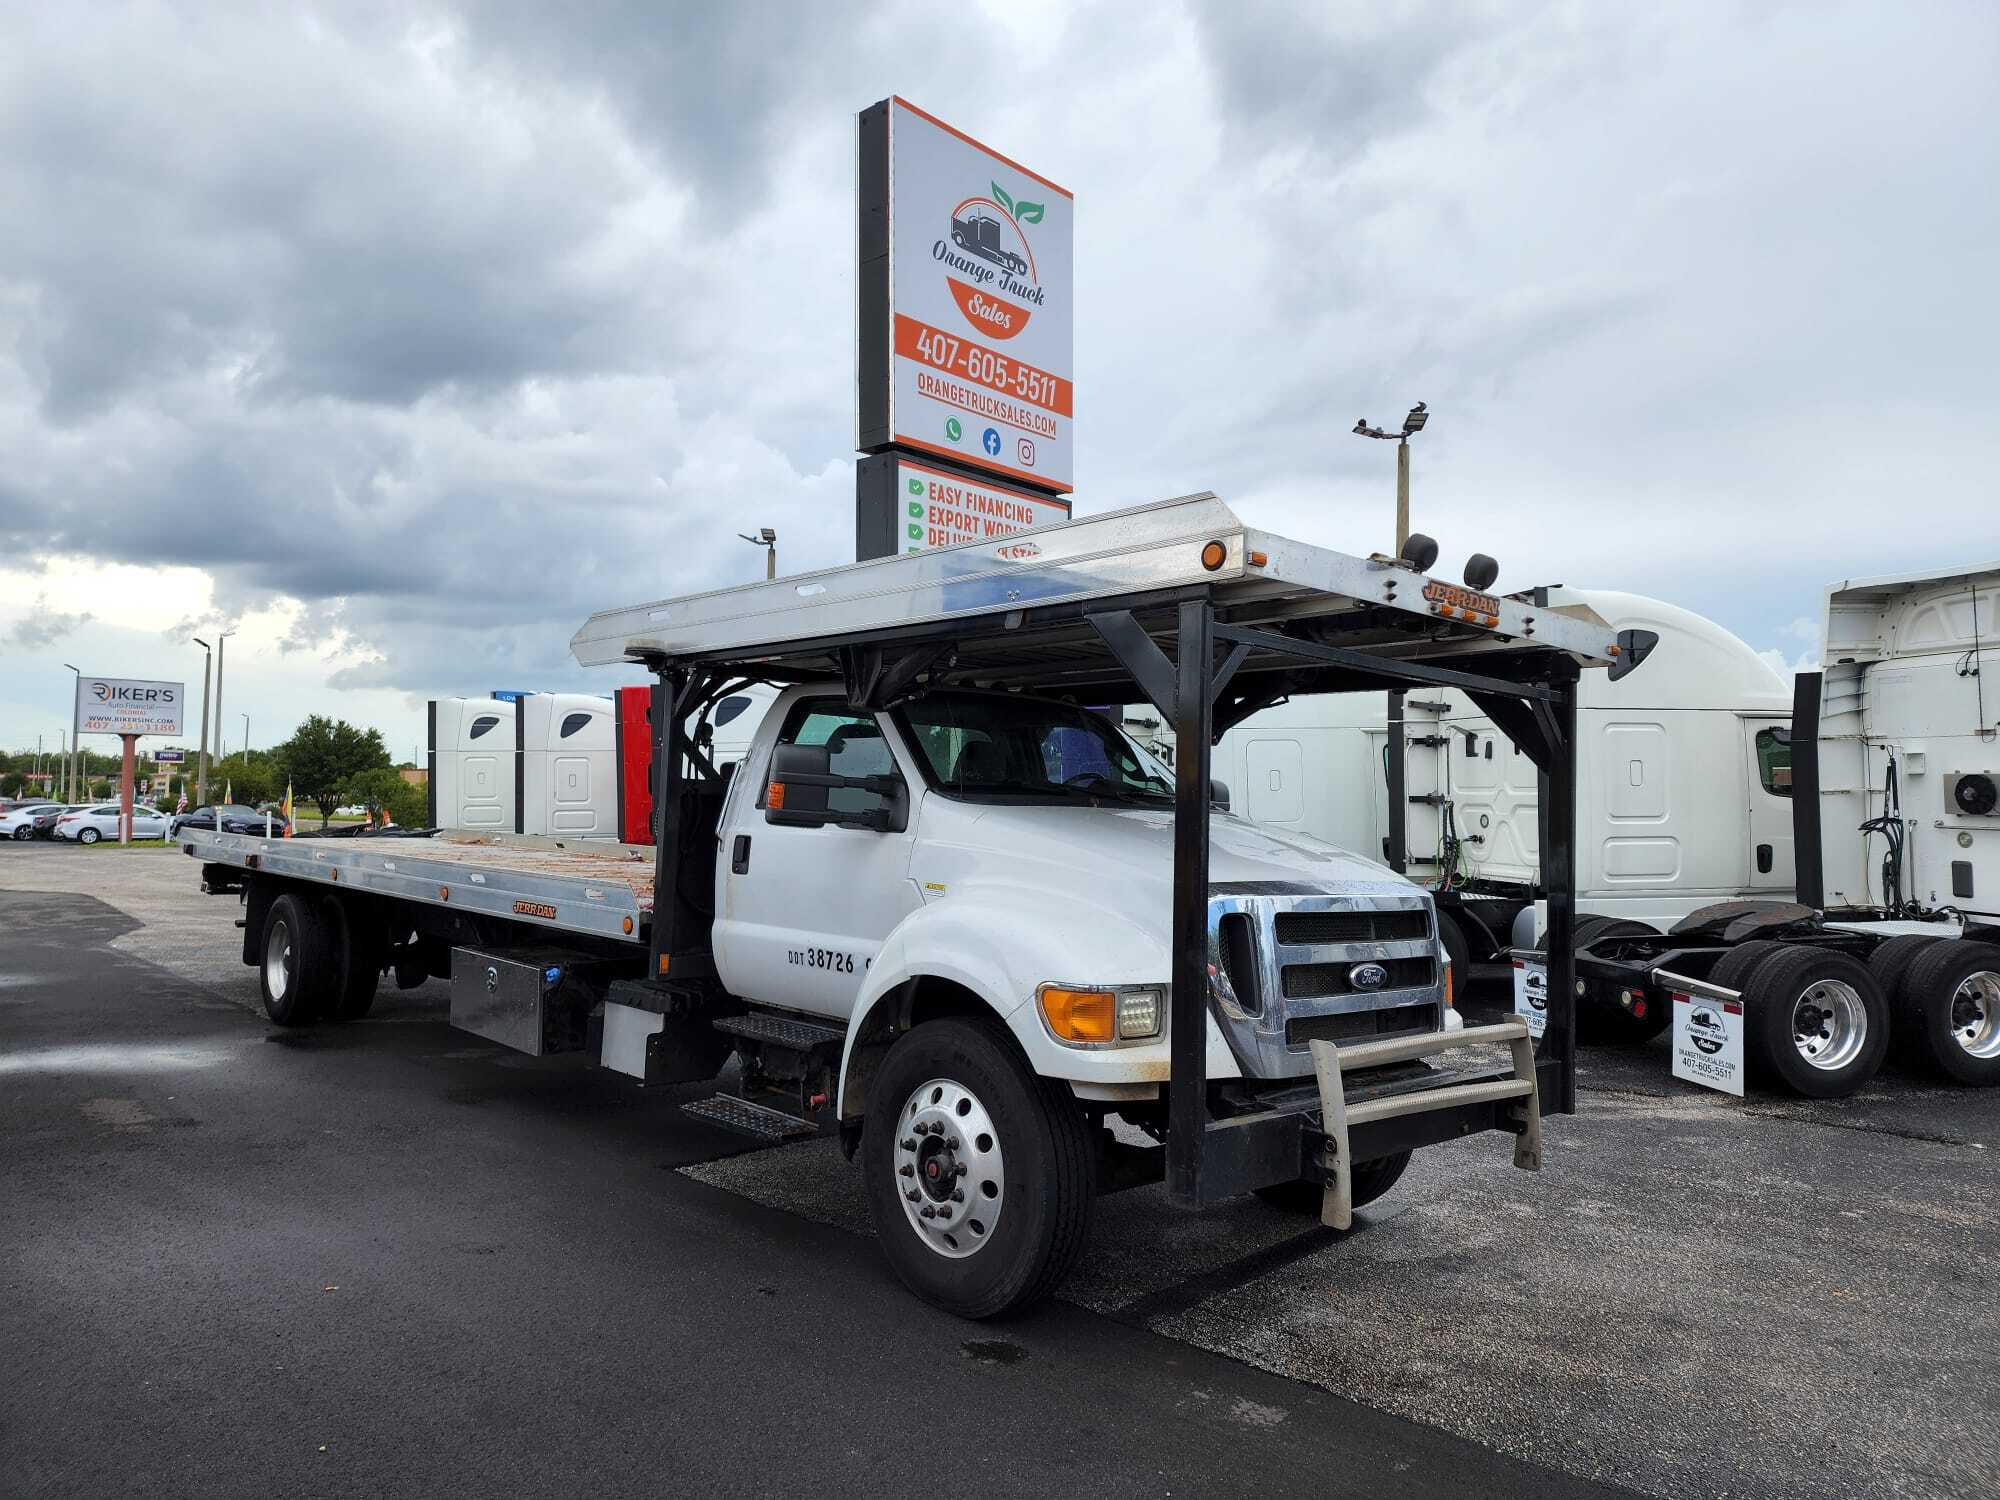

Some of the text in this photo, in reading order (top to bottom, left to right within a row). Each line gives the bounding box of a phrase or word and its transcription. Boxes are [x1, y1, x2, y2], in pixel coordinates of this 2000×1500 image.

[932, 239, 1045, 306] Orange Truck
[967, 293, 1013, 329] Sales
[916, 328, 1057, 407] 407-605-5511
[917, 372, 1057, 437] ORANGETRUCKSALES.COM
[928, 481, 1033, 524] EASY FINANCING
[928, 505, 980, 534] EXPORT
[92, 682, 175, 703] RIKER'S
[788, 950, 804, 966] DOT
[807, 948, 854, 973] 38726
[1361, 968, 1382, 984] Ford
[1682, 1057, 1732, 1080] 407-605-5511
